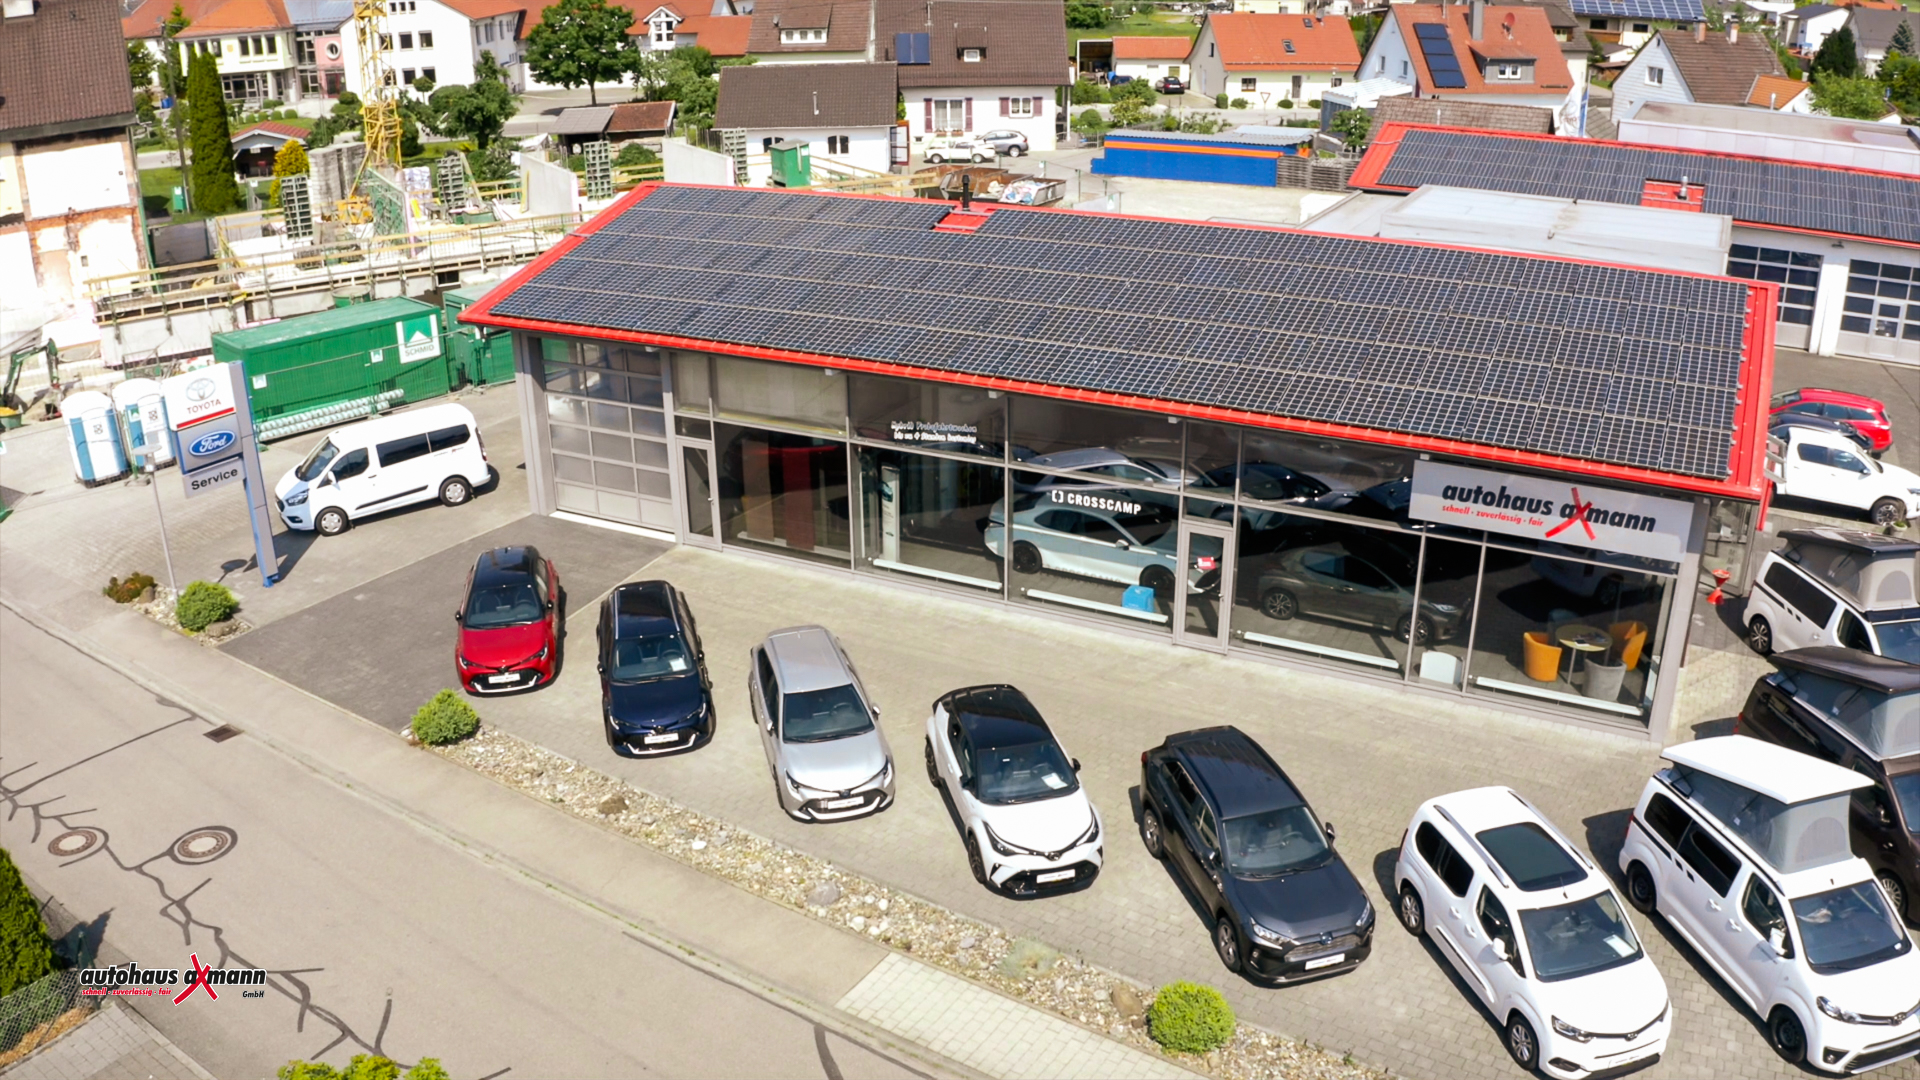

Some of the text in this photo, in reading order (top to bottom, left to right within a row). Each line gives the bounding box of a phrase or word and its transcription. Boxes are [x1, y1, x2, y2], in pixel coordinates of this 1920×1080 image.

[405, 344, 434, 357] SCHMID
[187, 399, 221, 414] TOYOTA
[199, 434, 227, 452] Ford
[191, 468, 238, 490] Service
[1067, 493, 1141, 515] CROSSCAMP
[1442, 484, 1554, 516] autohaus
[1442, 504, 1544, 527] schnell zuverlässig fair
